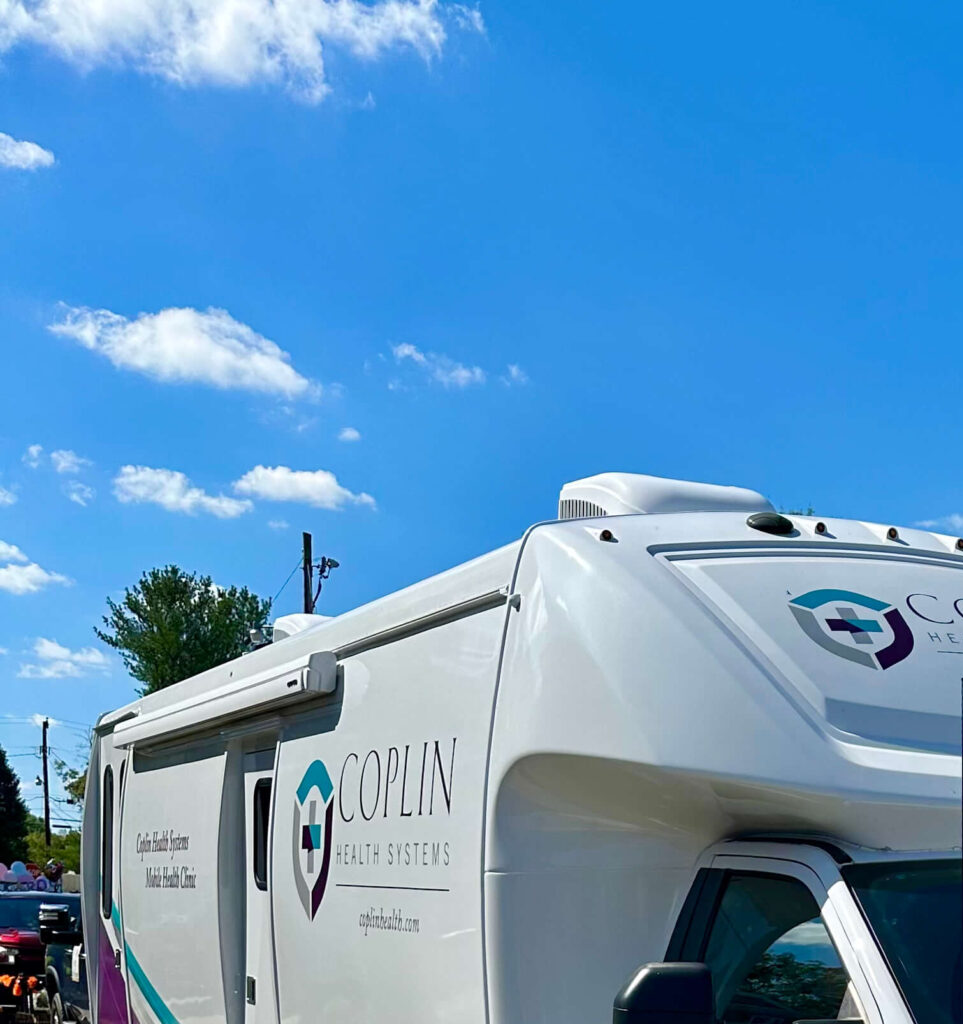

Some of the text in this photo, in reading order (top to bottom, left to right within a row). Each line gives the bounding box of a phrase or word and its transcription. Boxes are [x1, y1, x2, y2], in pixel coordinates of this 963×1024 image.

[339, 737, 457, 823] COPLIN
[136, 829, 190, 862] Coplin Health Systems
[336, 842, 450, 867] HEALTH SYSTEMS
[162, 866, 180, 889] Health
[180, 866, 197, 889] Clinic
[359, 906, 420, 936] coplinhealth.com
